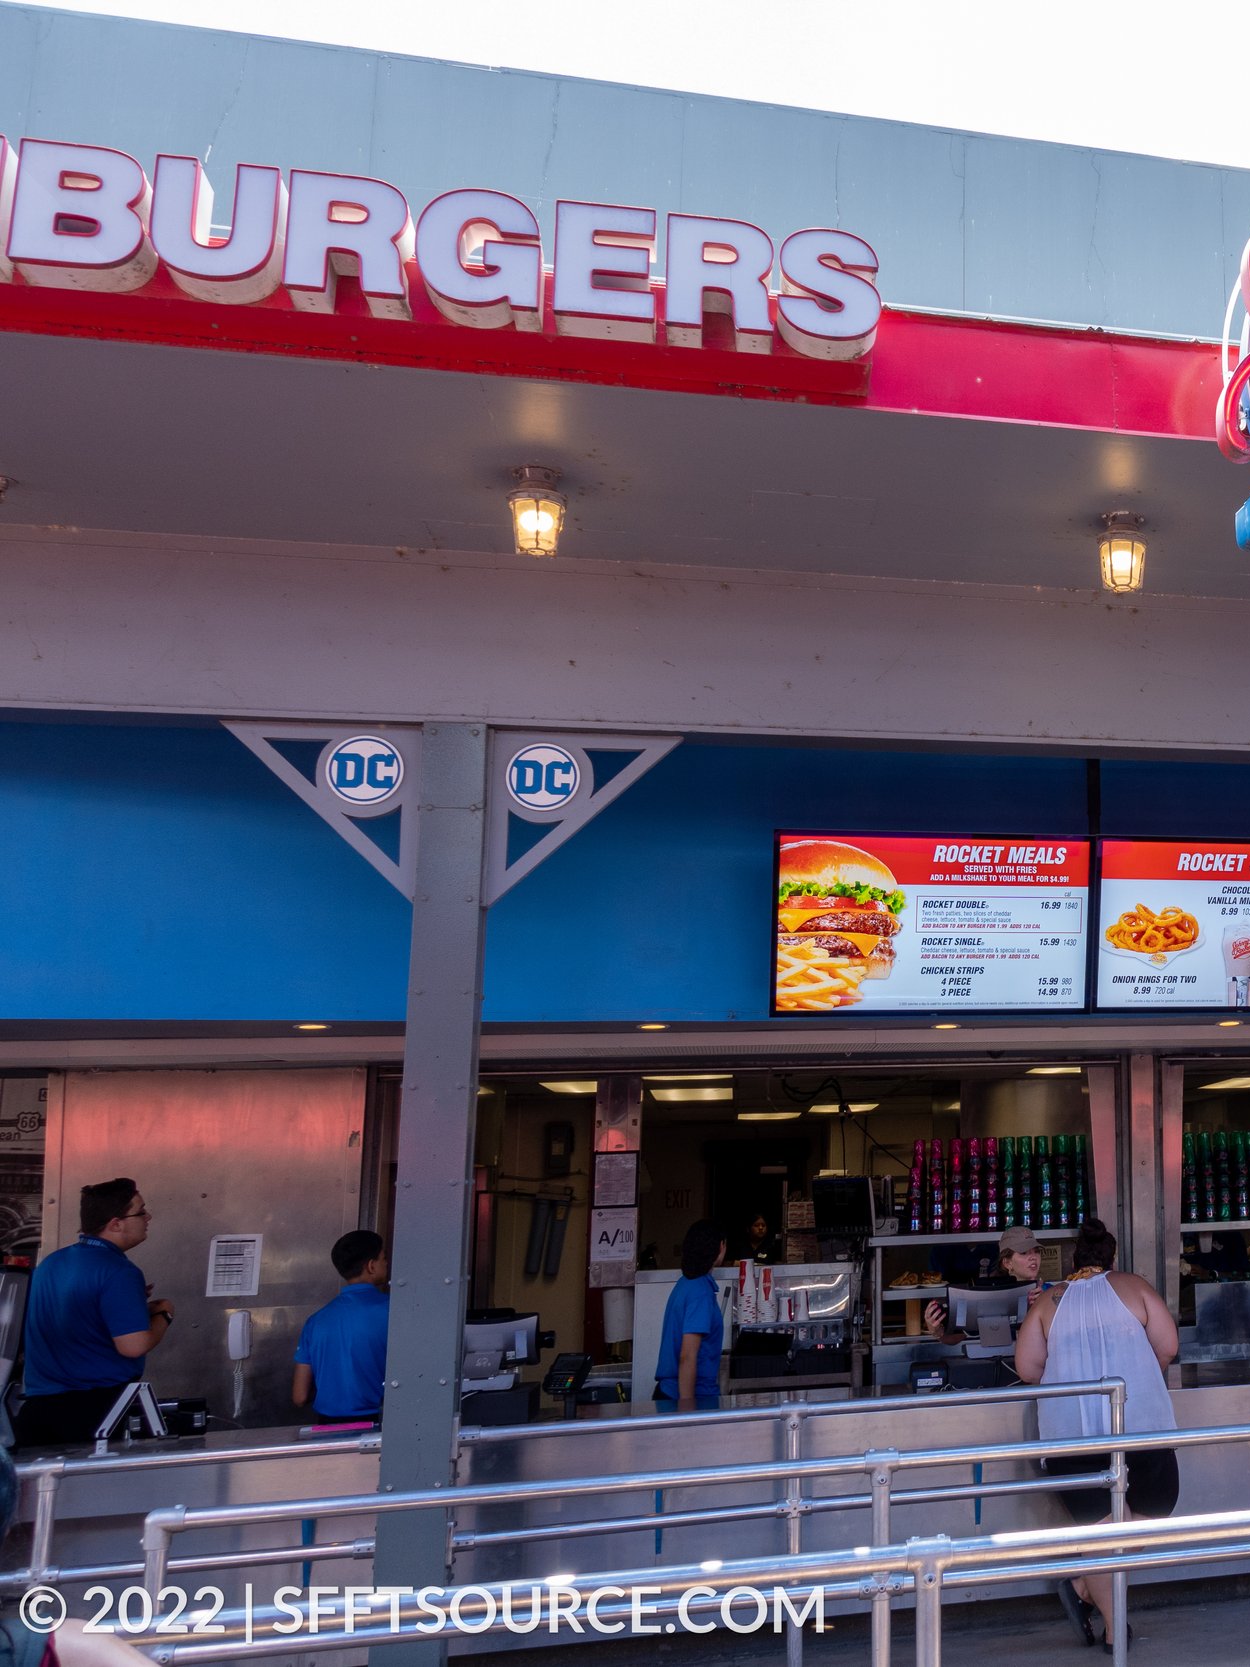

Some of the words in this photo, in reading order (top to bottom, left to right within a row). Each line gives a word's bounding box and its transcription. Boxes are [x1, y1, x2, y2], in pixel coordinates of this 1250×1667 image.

[0, 137, 880, 350] BURGERS
[333, 752, 397, 789] DC
[514, 759, 573, 796] DC
[933, 845, 1005, 863] ROCKET
[1007, 846, 1067, 865] MEALS
[1177, 853, 1247, 872] ROCKET
[964, 865, 993, 873] SERVED
[995, 865, 1015, 873] WITH
[1016, 866, 1037, 874] FRIES
[922, 900, 954, 909] ROCKET
[1040, 901, 1061, 909] 16.99
[1207, 897, 1237, 905] VANILLA
[921, 937, 953, 946] ROCKET
[1040, 938, 1060, 946] 15.99
[921, 966, 955, 974] CHICKEN
[956, 967, 985, 975] STRIPS
[1038, 977, 1058, 985] 15.99
[1112, 975, 1136, 983] ONION
[1137, 975, 1161, 983] RINGS
[1162, 975, 1178, 983] FOR
[1180, 975, 1197, 983] TWO
[941, 988, 946, 996] 3
[948, 988, 971, 996] PIECE
[1038, 988, 1058, 996] 14.99
[20, 1115, 37, 1129] 66
[664, 1188, 692, 1210] EXIT
